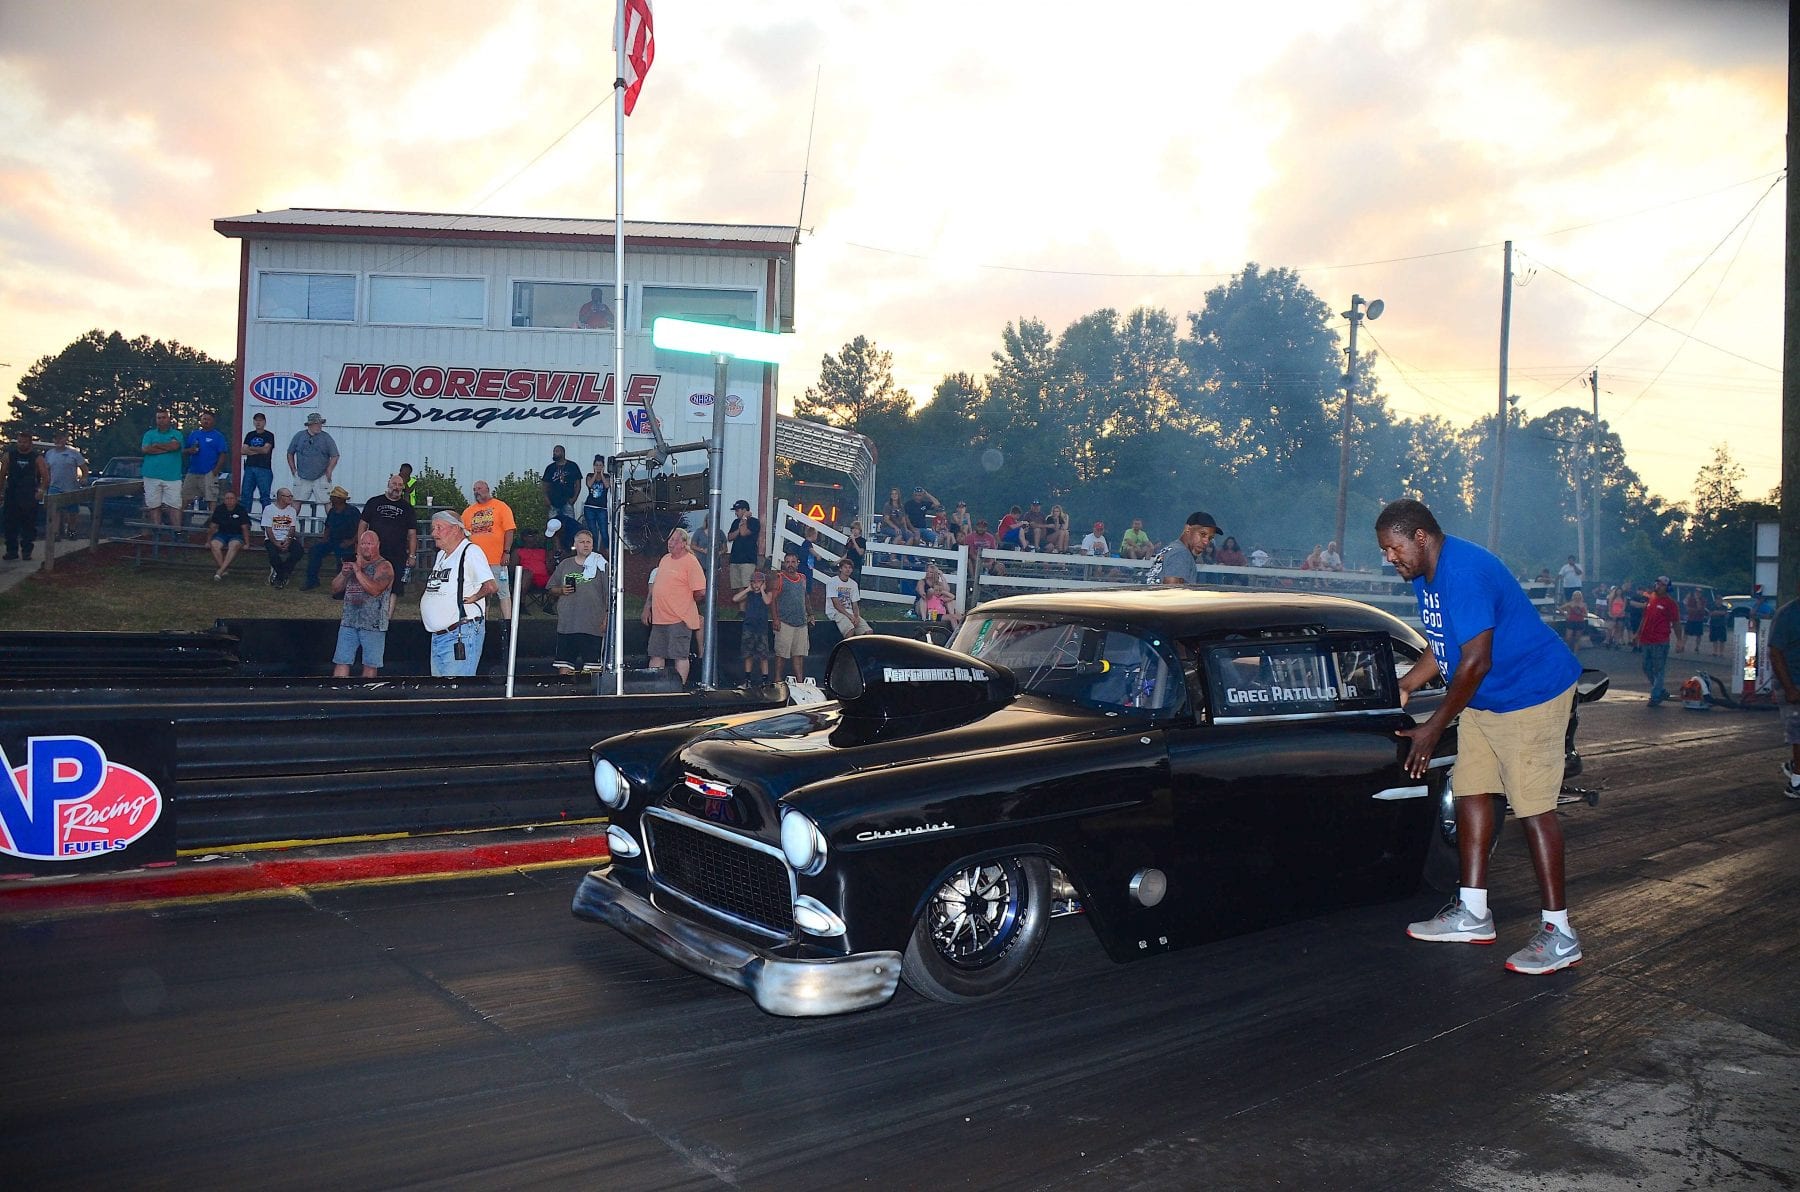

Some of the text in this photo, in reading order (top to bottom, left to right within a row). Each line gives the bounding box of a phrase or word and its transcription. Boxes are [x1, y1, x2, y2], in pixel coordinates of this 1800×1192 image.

[260, 378, 308, 399] NHRA
[335, 363, 661, 406] MOORESVILLE
[375, 401, 600, 429] Dragway
[1227, 687, 1268, 703] GREG
[63, 794, 157, 841] Racing
[856, 821, 955, 841] Chevrolet
[63, 840, 127, 854] FUELS
